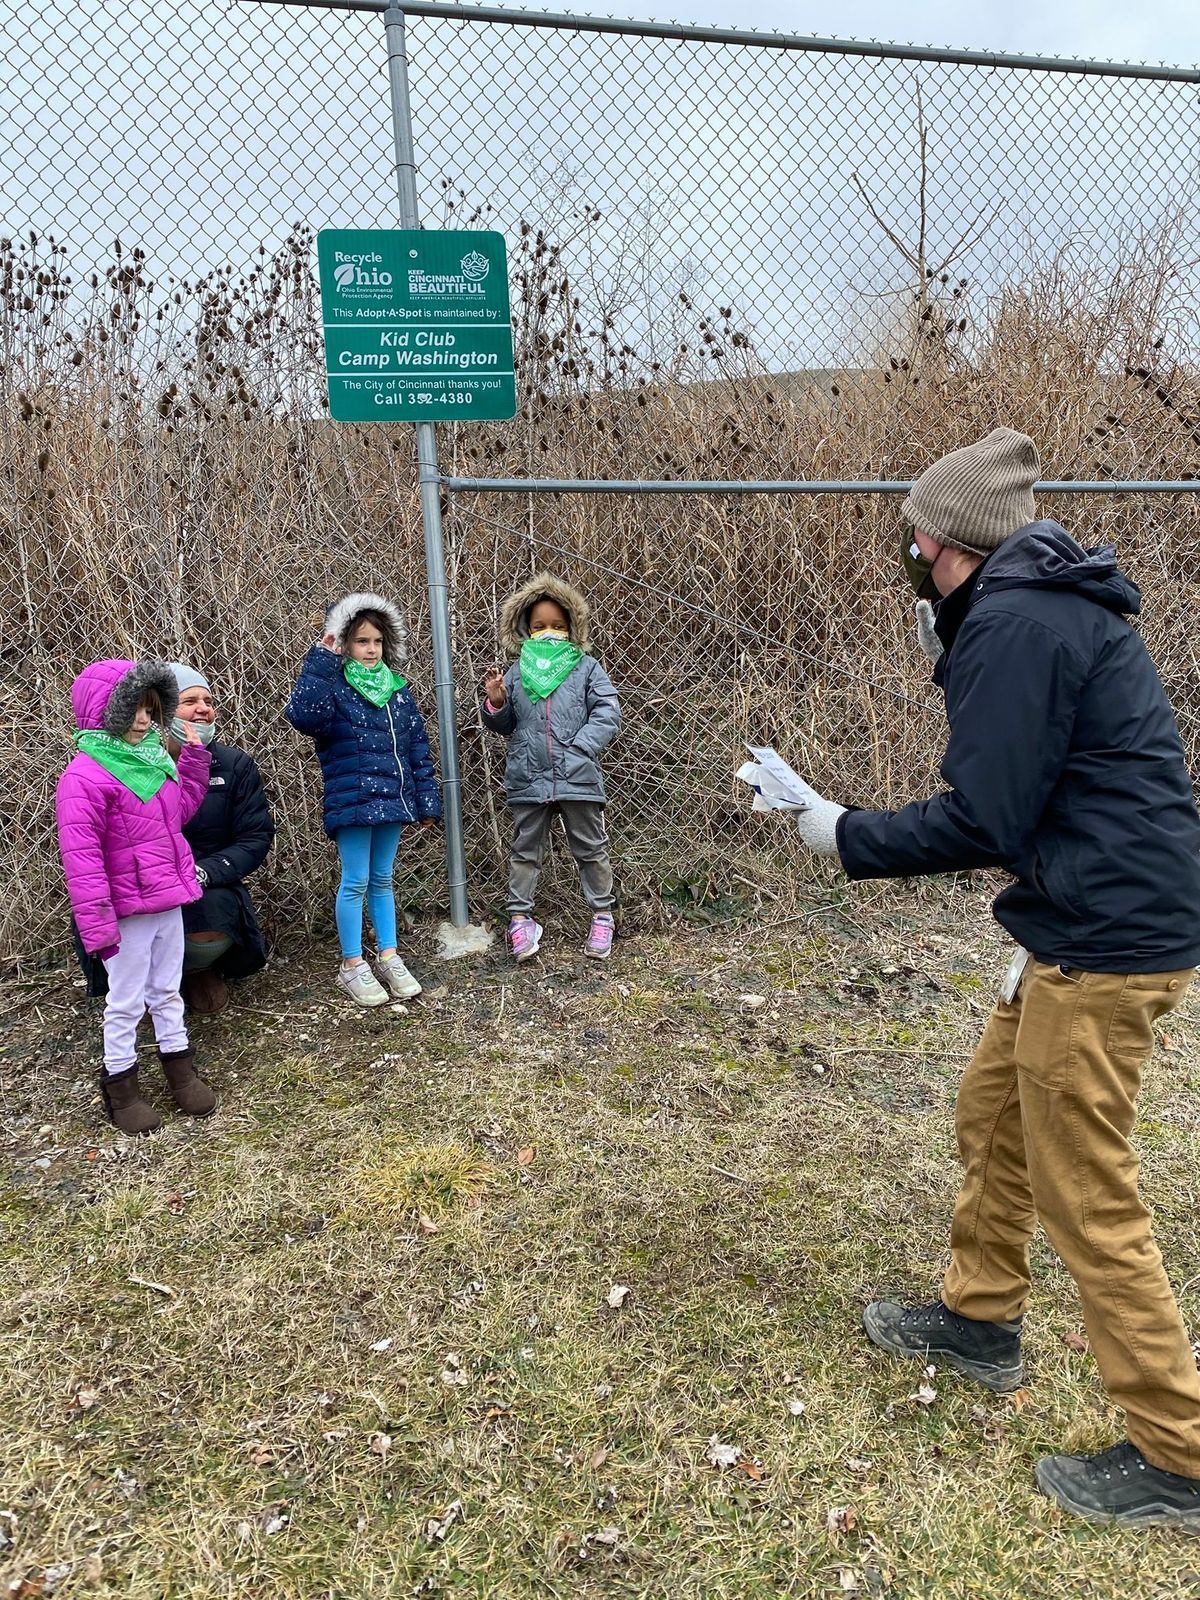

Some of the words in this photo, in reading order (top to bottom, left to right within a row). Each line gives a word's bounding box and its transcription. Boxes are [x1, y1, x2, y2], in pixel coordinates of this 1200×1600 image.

[335, 251, 382, 266] Recycle
[408, 275, 464, 283] CINCINNATI
[409, 283, 486, 293] BEAUTIFUL
[333, 308, 353, 317] This
[424, 308, 431, 317] is
[434, 308, 484, 317] maintained
[486, 308, 501, 319] by:
[380, 332, 409, 347] Kid
[415, 331, 456, 346] Club
[339, 351, 390, 369] Camp
[396, 350, 498, 368] Washington
[342, 380, 361, 389] The
[364, 380, 384, 391] City
[386, 380, 395, 389] of
[398, 379, 445, 389] Cincinnati
[448, 379, 479, 389] thanks
[481, 379, 501, 390] you!
[374, 393, 403, 405] Call
[408, 392, 473, 405] 352-4380
